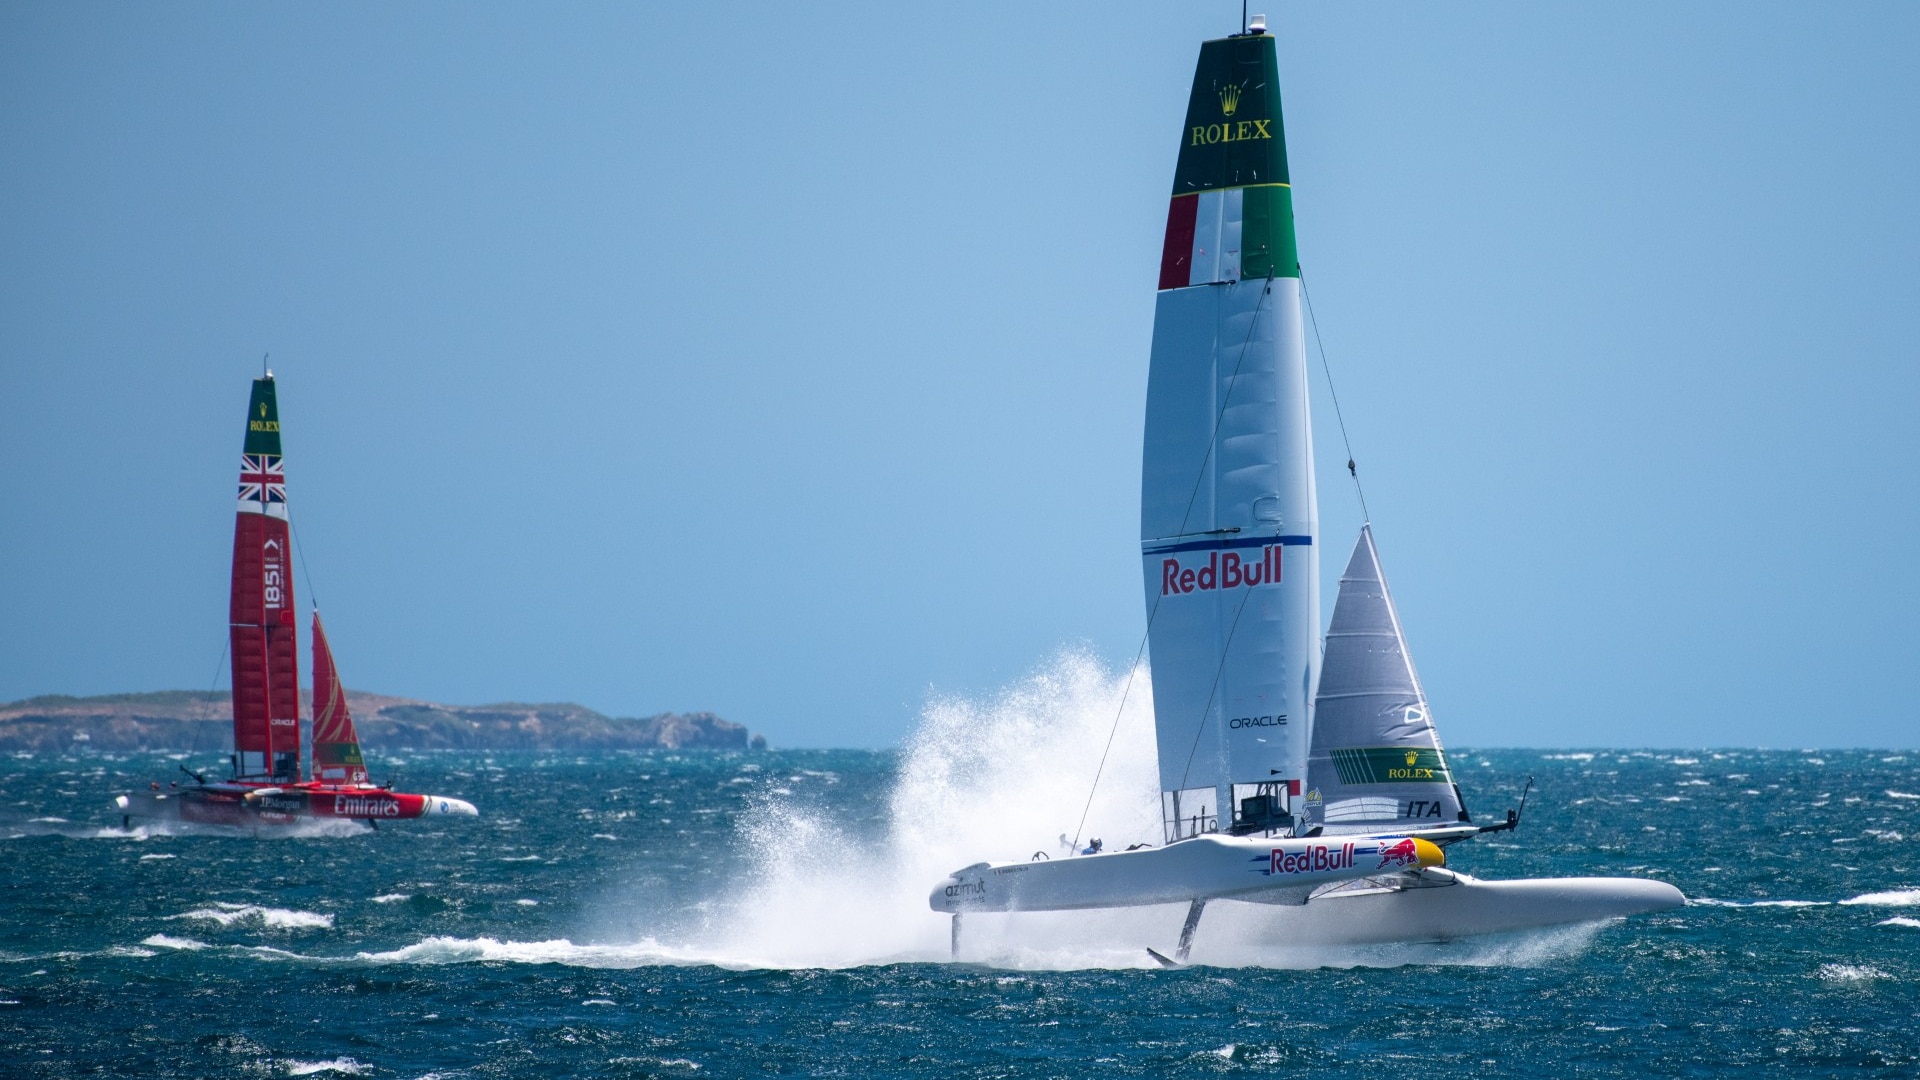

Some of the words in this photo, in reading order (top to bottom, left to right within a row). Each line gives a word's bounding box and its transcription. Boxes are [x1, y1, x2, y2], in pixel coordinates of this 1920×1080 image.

[1191, 119, 1272, 146] ROLEX
[250, 420, 279, 432] ROLEX
[264, 564, 280, 609] 1851
[1229, 714, 1288, 729] ORACLE
[1388, 768, 1434, 779] ROLEX
[334, 794, 400, 817] Emirates
[1406, 800, 1442, 818] ITA
[945, 877, 986, 897] azimut
